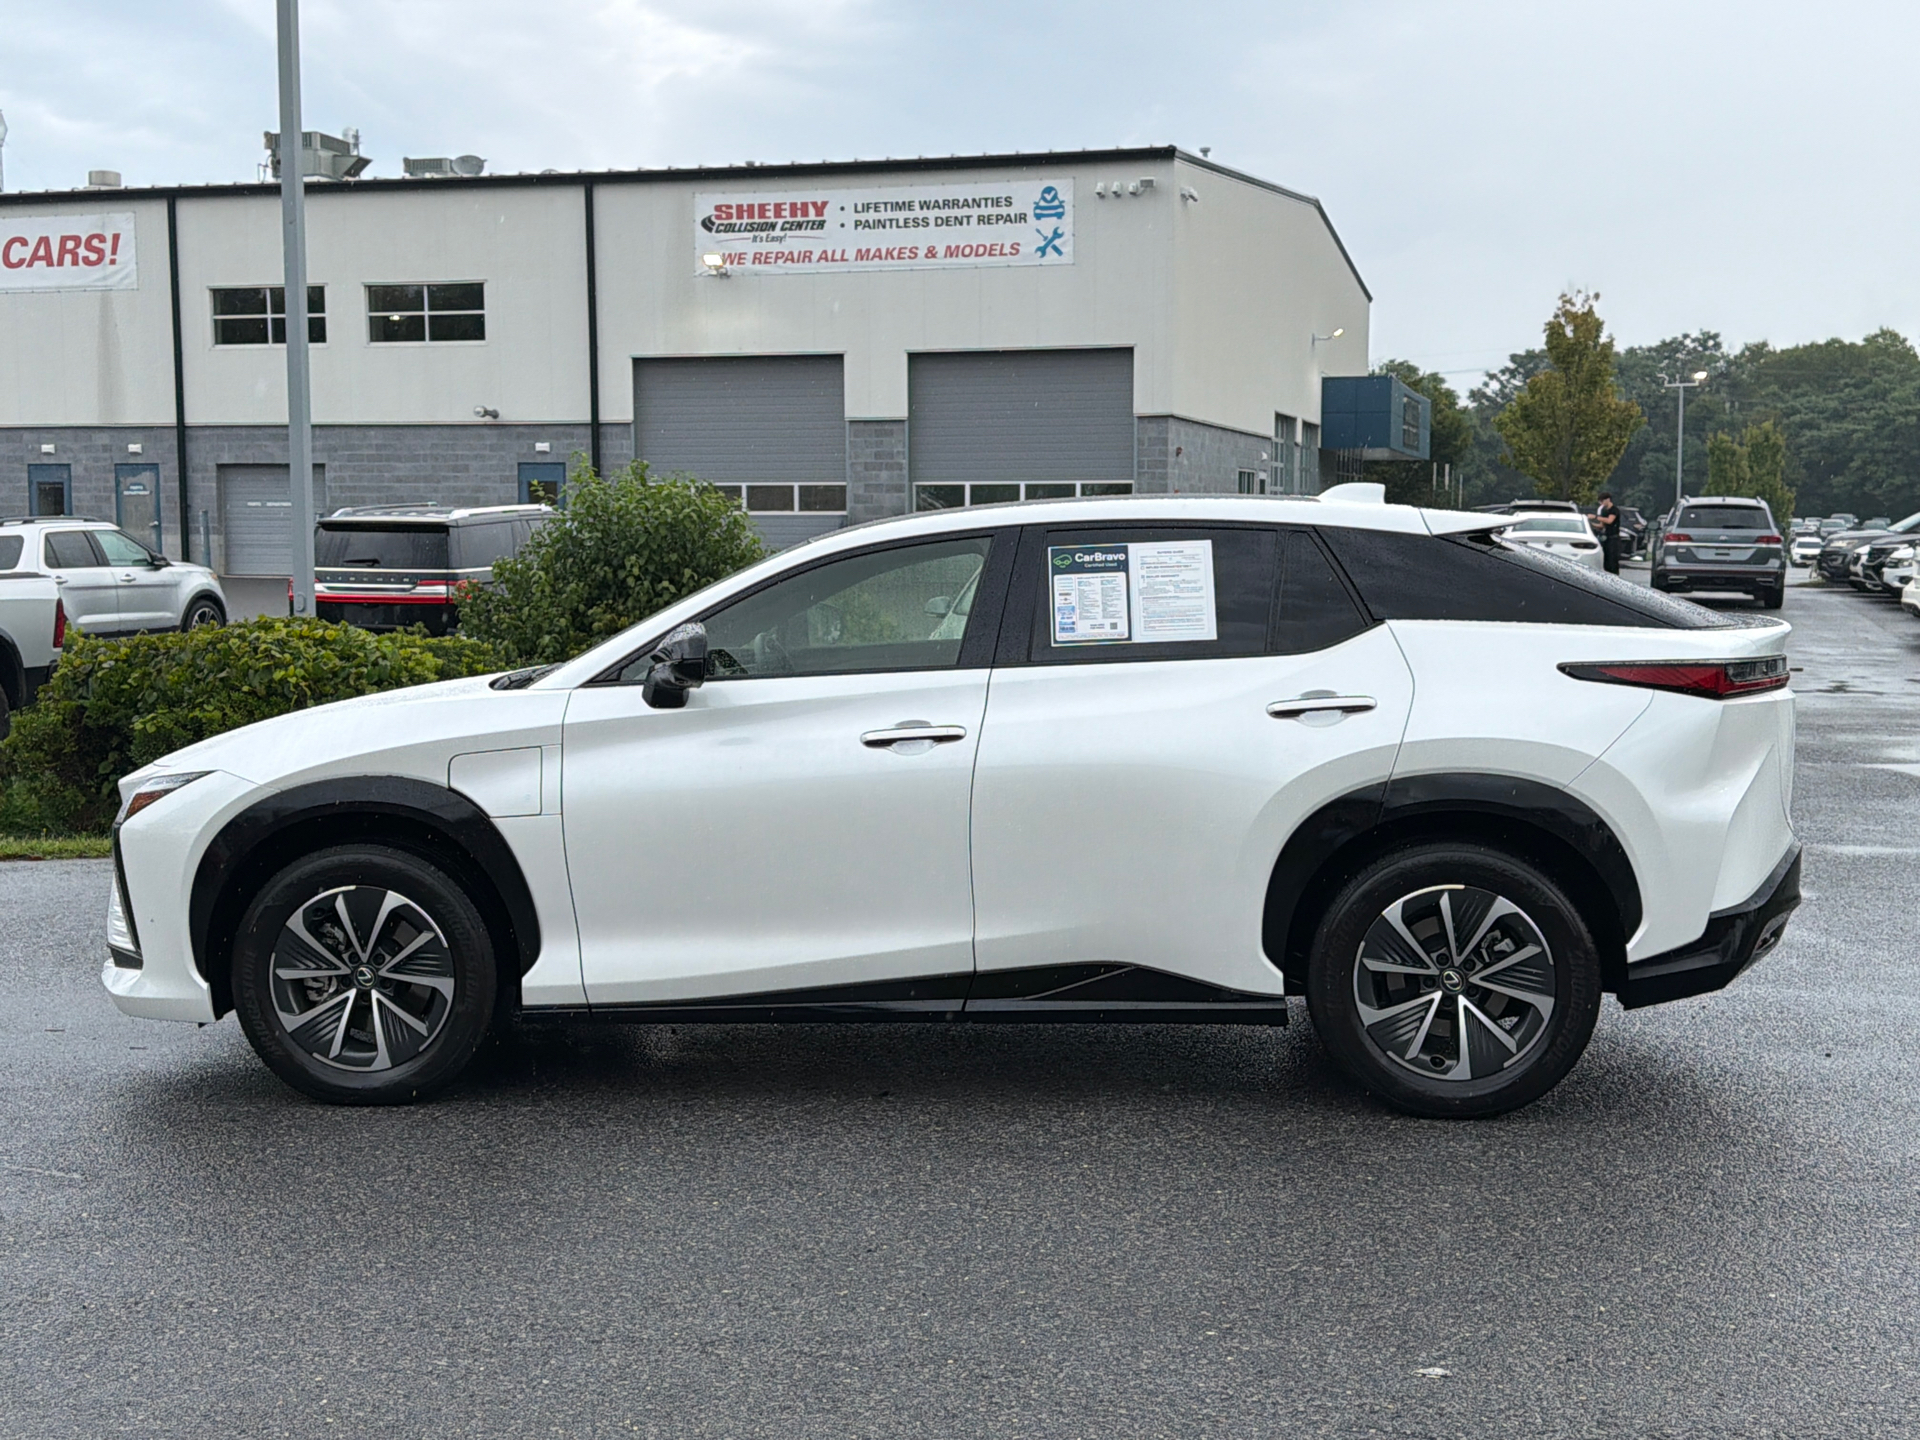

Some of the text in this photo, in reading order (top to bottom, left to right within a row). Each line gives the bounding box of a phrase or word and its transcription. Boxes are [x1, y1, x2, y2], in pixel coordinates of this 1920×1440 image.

[713, 201, 829, 221] SHEEHY
[853, 195, 1013, 214] LIFETIME WARRANTIES
[714, 219, 827, 233] COLLISION CENTER
[853, 212, 1028, 231] PAINTLESS DENT REPAIR
[751, 232, 788, 244] It's Easy!
[2, 232, 121, 269] CARS!
[721, 242, 1021, 266] WE REPAIR ALL MAKES & MODELS
[1075, 552, 1126, 563] CarBravo
